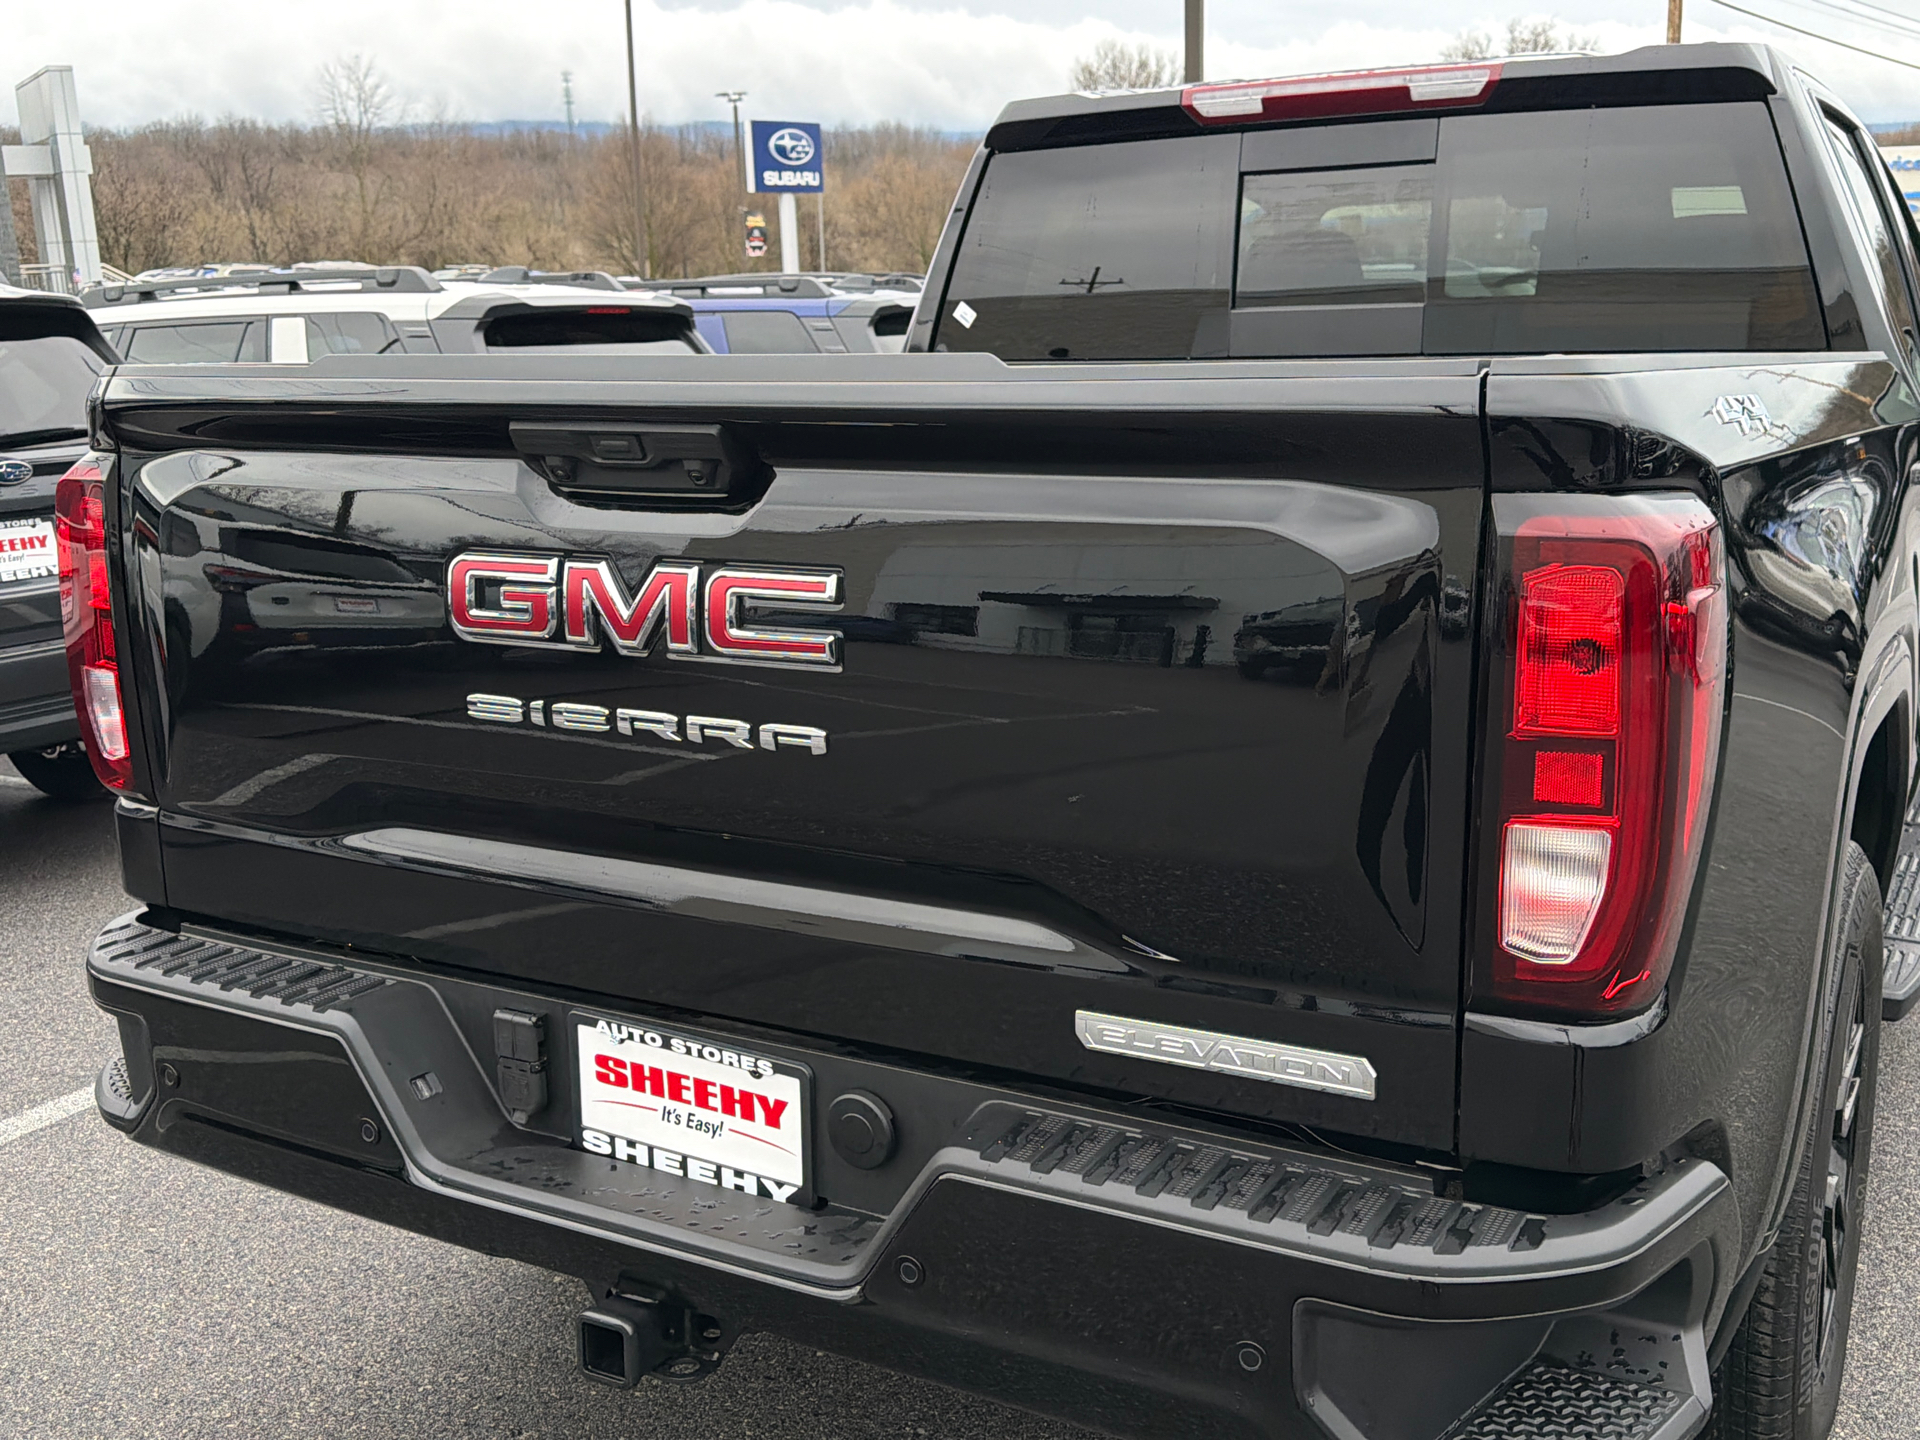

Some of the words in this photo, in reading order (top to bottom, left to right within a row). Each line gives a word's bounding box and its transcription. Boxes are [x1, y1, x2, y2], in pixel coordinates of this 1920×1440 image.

[763, 170, 820, 186] SUBARU
[449, 552, 843, 672] GMC
[466, 693, 828, 756] SIERRA
[595, 1020, 663, 1047] AUTO
[670, 1037, 775, 1077] STORES
[1097, 1024, 1352, 1085] ELEVATION
[594, 1053, 789, 1130] SHEEHY
[661, 1105, 682, 1126] It's
[686, 1112, 725, 1139] Easy!
[582, 1129, 799, 1204] SHEEHY
